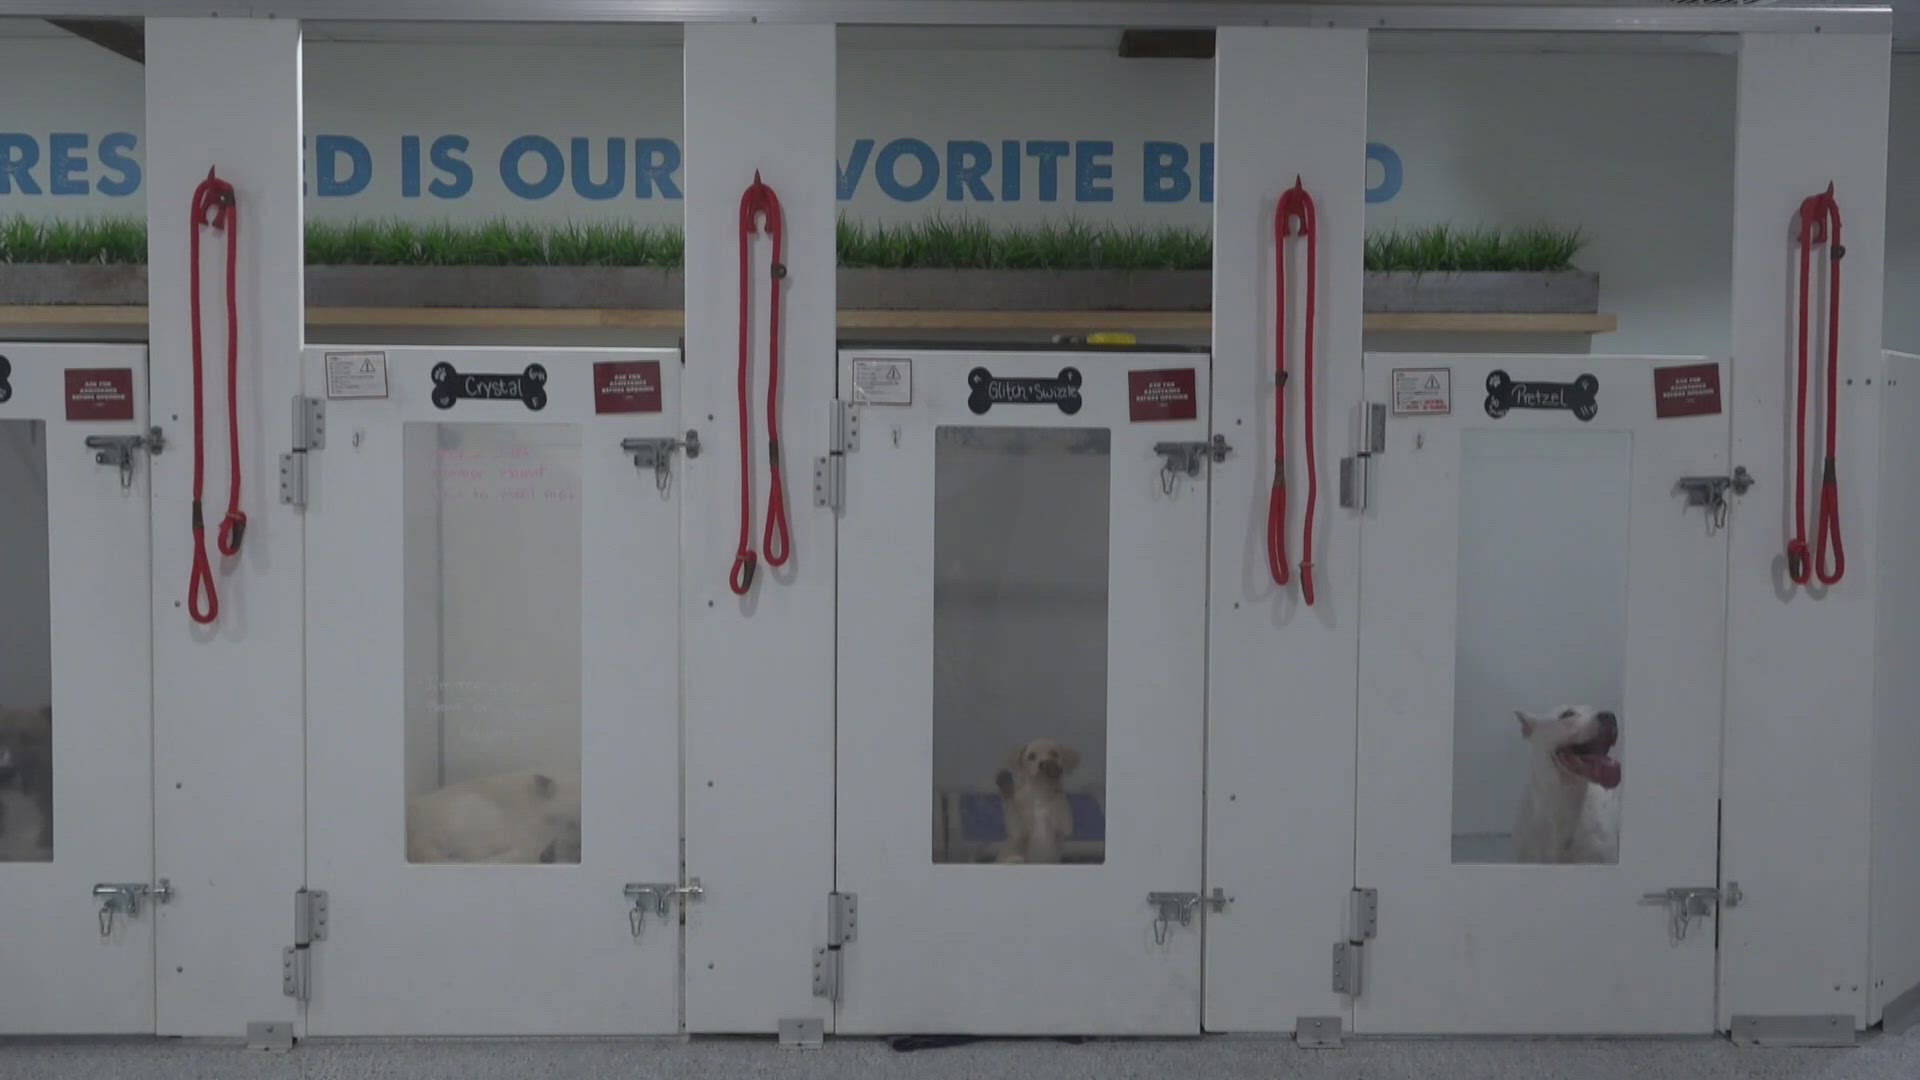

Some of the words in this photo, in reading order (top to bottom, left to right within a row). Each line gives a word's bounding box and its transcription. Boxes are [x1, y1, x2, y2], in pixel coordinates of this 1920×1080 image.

[402, 135, 473, 199] IS
[501, 136, 684, 200] OUR
[837, 139, 1113, 203] VORITE
[465, 376, 524, 399] Crystal
[988, 380, 1027, 401] Glitch
[1033, 383, 1079, 400] Swizzle
[1511, 383, 1568, 408] Pretzel
